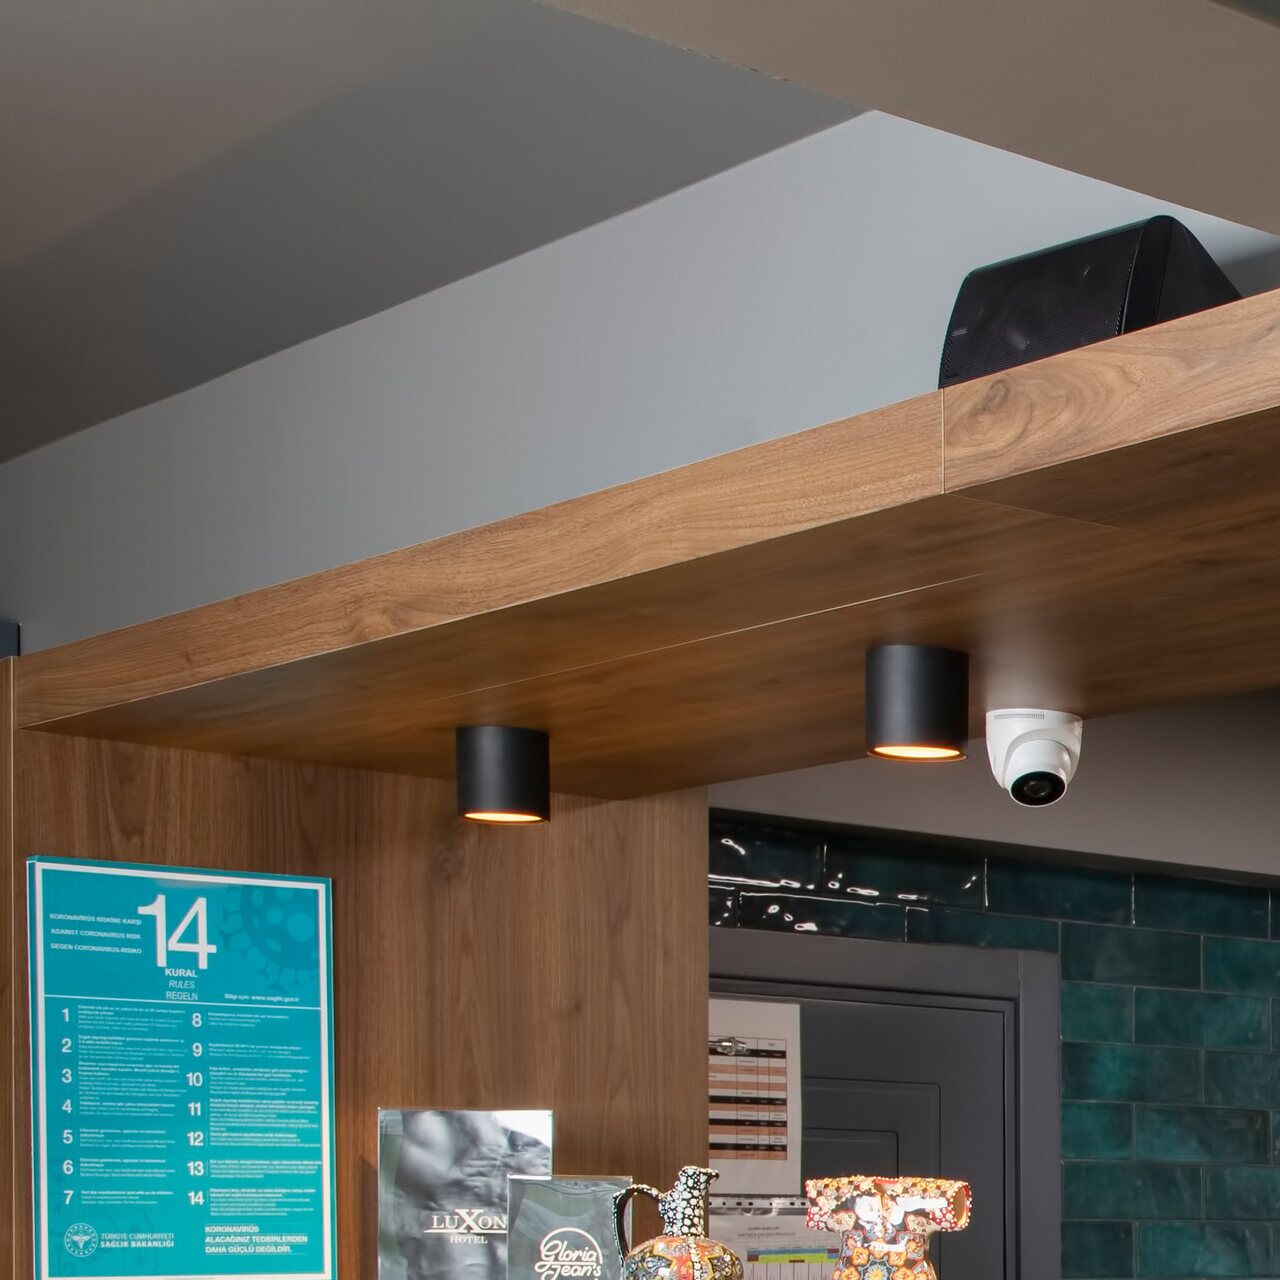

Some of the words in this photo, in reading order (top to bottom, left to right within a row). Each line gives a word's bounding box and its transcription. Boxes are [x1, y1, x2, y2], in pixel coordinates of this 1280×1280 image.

[137, 894, 217, 970] 14
[165, 968, 198, 978] KURAL
[168, 979, 196, 989] RULES
[165, 991, 198, 1001] REGELN
[61, 1008, 70, 1022] 1
[191, 1012, 203, 1027] 8
[61, 1037, 72, 1053] 2
[191, 1042, 203, 1057] 9
[61, 1068, 73, 1083] 3
[186, 1072, 203, 1087] 10
[62, 1098, 72, 1114] 4
[187, 1101, 202, 1116] 11
[62, 1129, 74, 1144] 5
[186, 1131, 205, 1146] 12
[62, 1159, 74, 1175] 6
[187, 1161, 205, 1176] 13
[63, 1190, 74, 1205] 7
[187, 1190, 205, 1206] 14
[450, 1234, 489, 1245] HOTEL
[535, 1240, 598, 1273] Gloria
